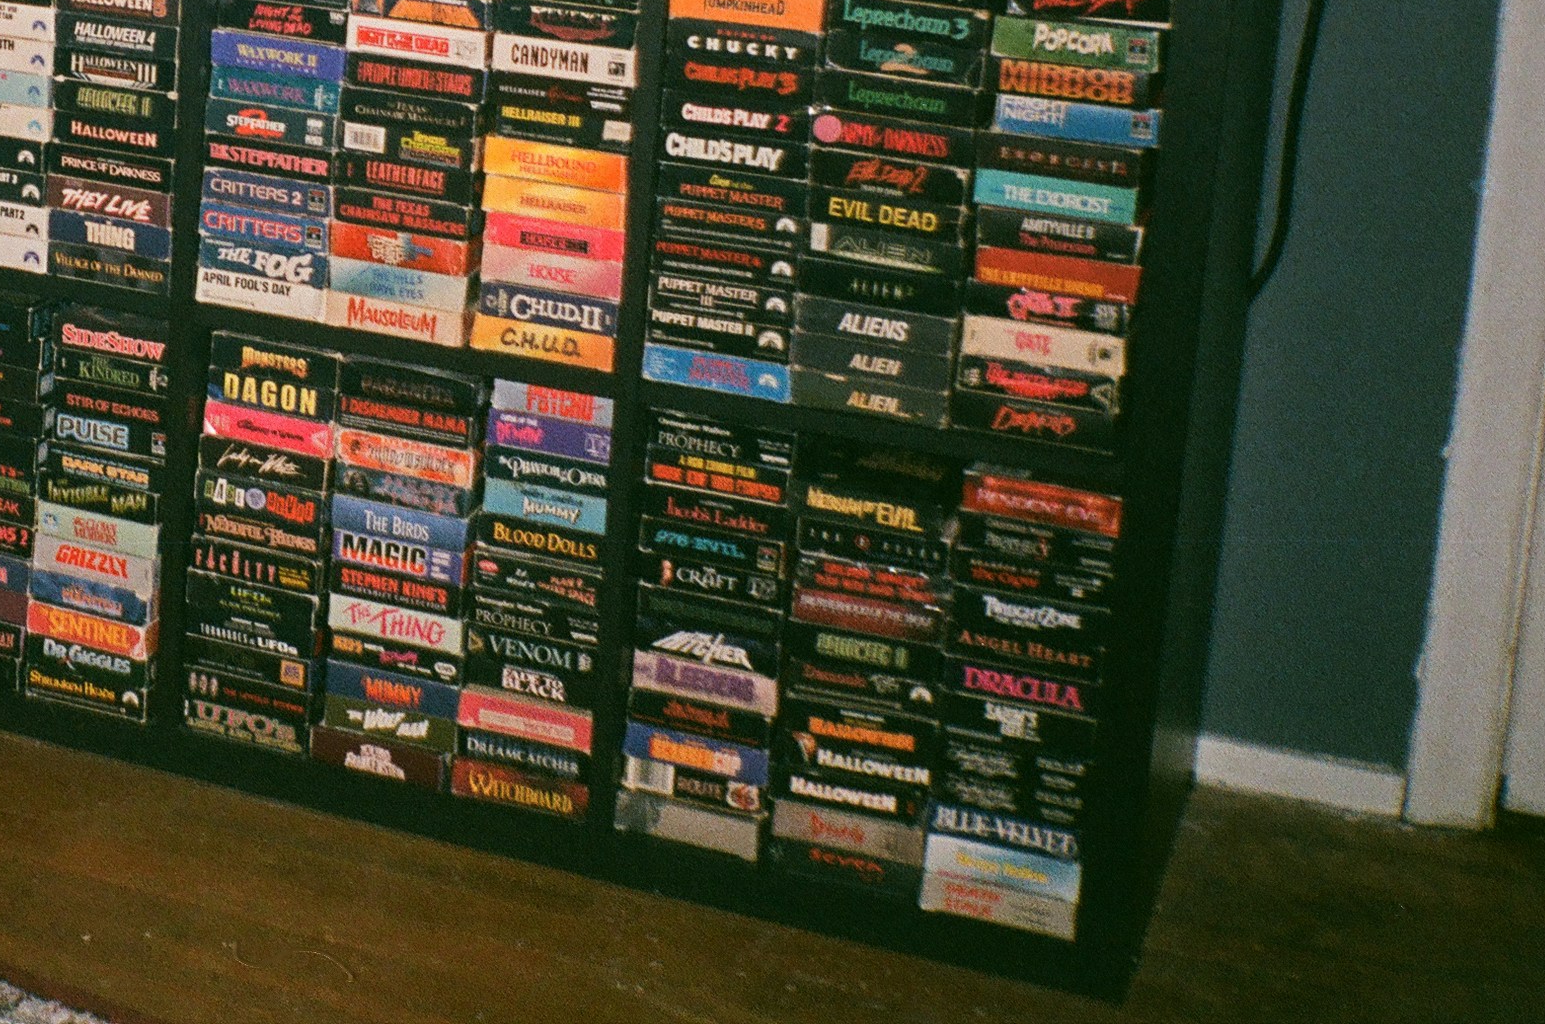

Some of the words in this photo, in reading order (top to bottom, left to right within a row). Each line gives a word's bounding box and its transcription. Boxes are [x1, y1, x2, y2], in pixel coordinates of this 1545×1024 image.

[511, 43, 589, 75] CANDYMAN
[685, 34, 799, 61] CHUCKY
[499, 83, 546, 99] HELLRAISER
[70, 120, 158, 149] HALLOWEEN
[11, 173, 18, 185] 3
[61, 156, 96, 172] PRINCE
[107, 162, 162, 183] DARKNESS
[366, 160, 445, 196] LEATHERFACE
[210, 177, 288, 203] CRITTERS
[290, 189, 303, 206] 2
[389, 198, 430, 219] TEXAS
[203, 209, 303, 244] CRITTERS
[827, 196, 877, 224] EVIL
[879, 205, 938, 233] DEAD
[202, 270, 232, 288] APRIL
[234, 275, 268, 294] FOOL'S
[269, 280, 291, 298] DAY
[347, 296, 438, 341] MAUSOLEUM
[837, 313, 909, 342] ALIENS
[62, 322, 166, 362] SIDESHOW
[849, 352, 902, 377] ALIEN
[223, 372, 318, 417] DAGON
[846, 391, 900, 415] ALIEN
[56, 412, 130, 451] PULSE
[364, 509, 391, 532] THE
[392, 514, 431, 542] BIRDS
[493, 522, 545, 549] BLOOD
[546, 532, 597, 559] DOLLS
[54, 544, 129, 579] GRIZZLY
[340, 533, 428, 575] MAGIC
[341, 568, 400, 597] STEPHEN
[401, 579, 449, 605] KING'S
[676, 563, 738, 592] CRAFT
[488, 634, 573, 670] VENOM
[963, 665, 1084, 710] DRACULA
[816, 748, 931, 786] HALLOWEEN
[467, 769, 575, 814] WITCHBOARD
[790, 775, 898, 813] HALLOWEEN
